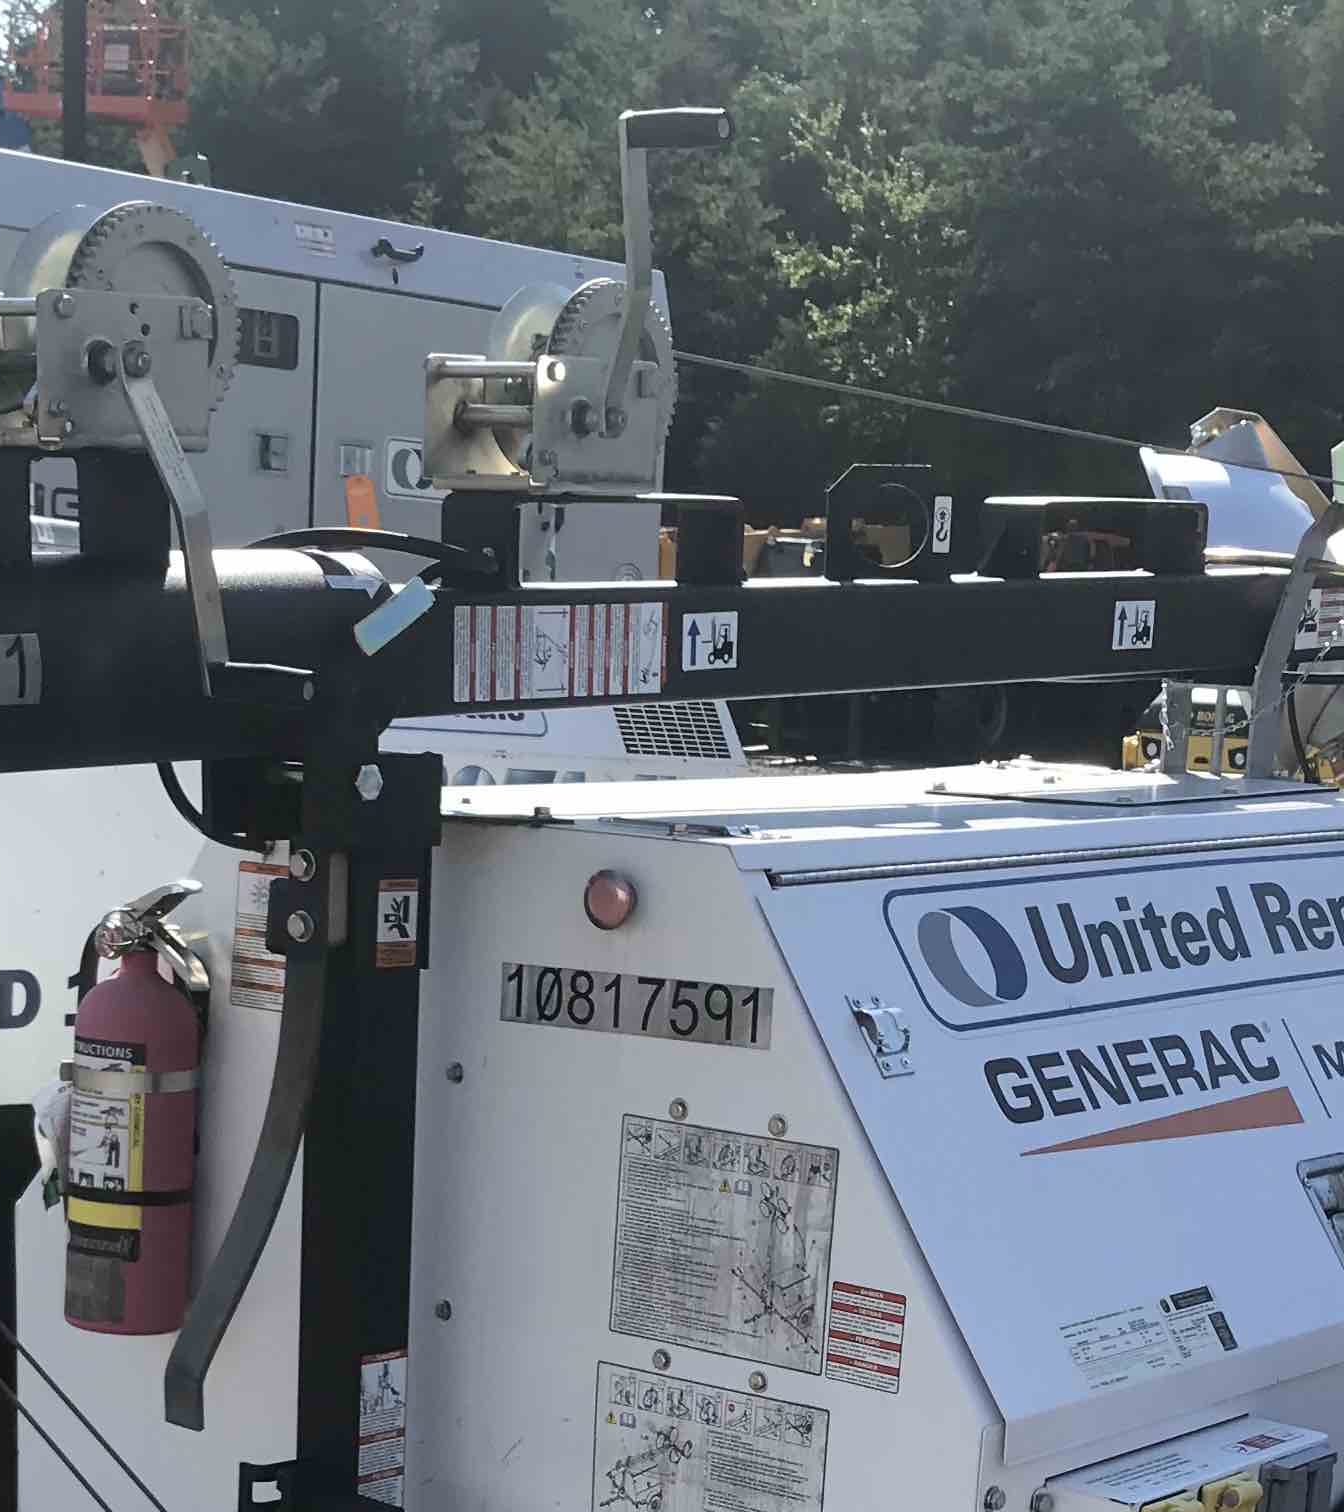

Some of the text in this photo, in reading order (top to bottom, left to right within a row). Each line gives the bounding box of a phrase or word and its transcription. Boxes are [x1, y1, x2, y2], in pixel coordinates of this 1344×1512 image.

[1024, 885, 1252, 985] United
[507, 965, 760, 1044] 10817591
[985, 1022, 1280, 1124] GENERAC
